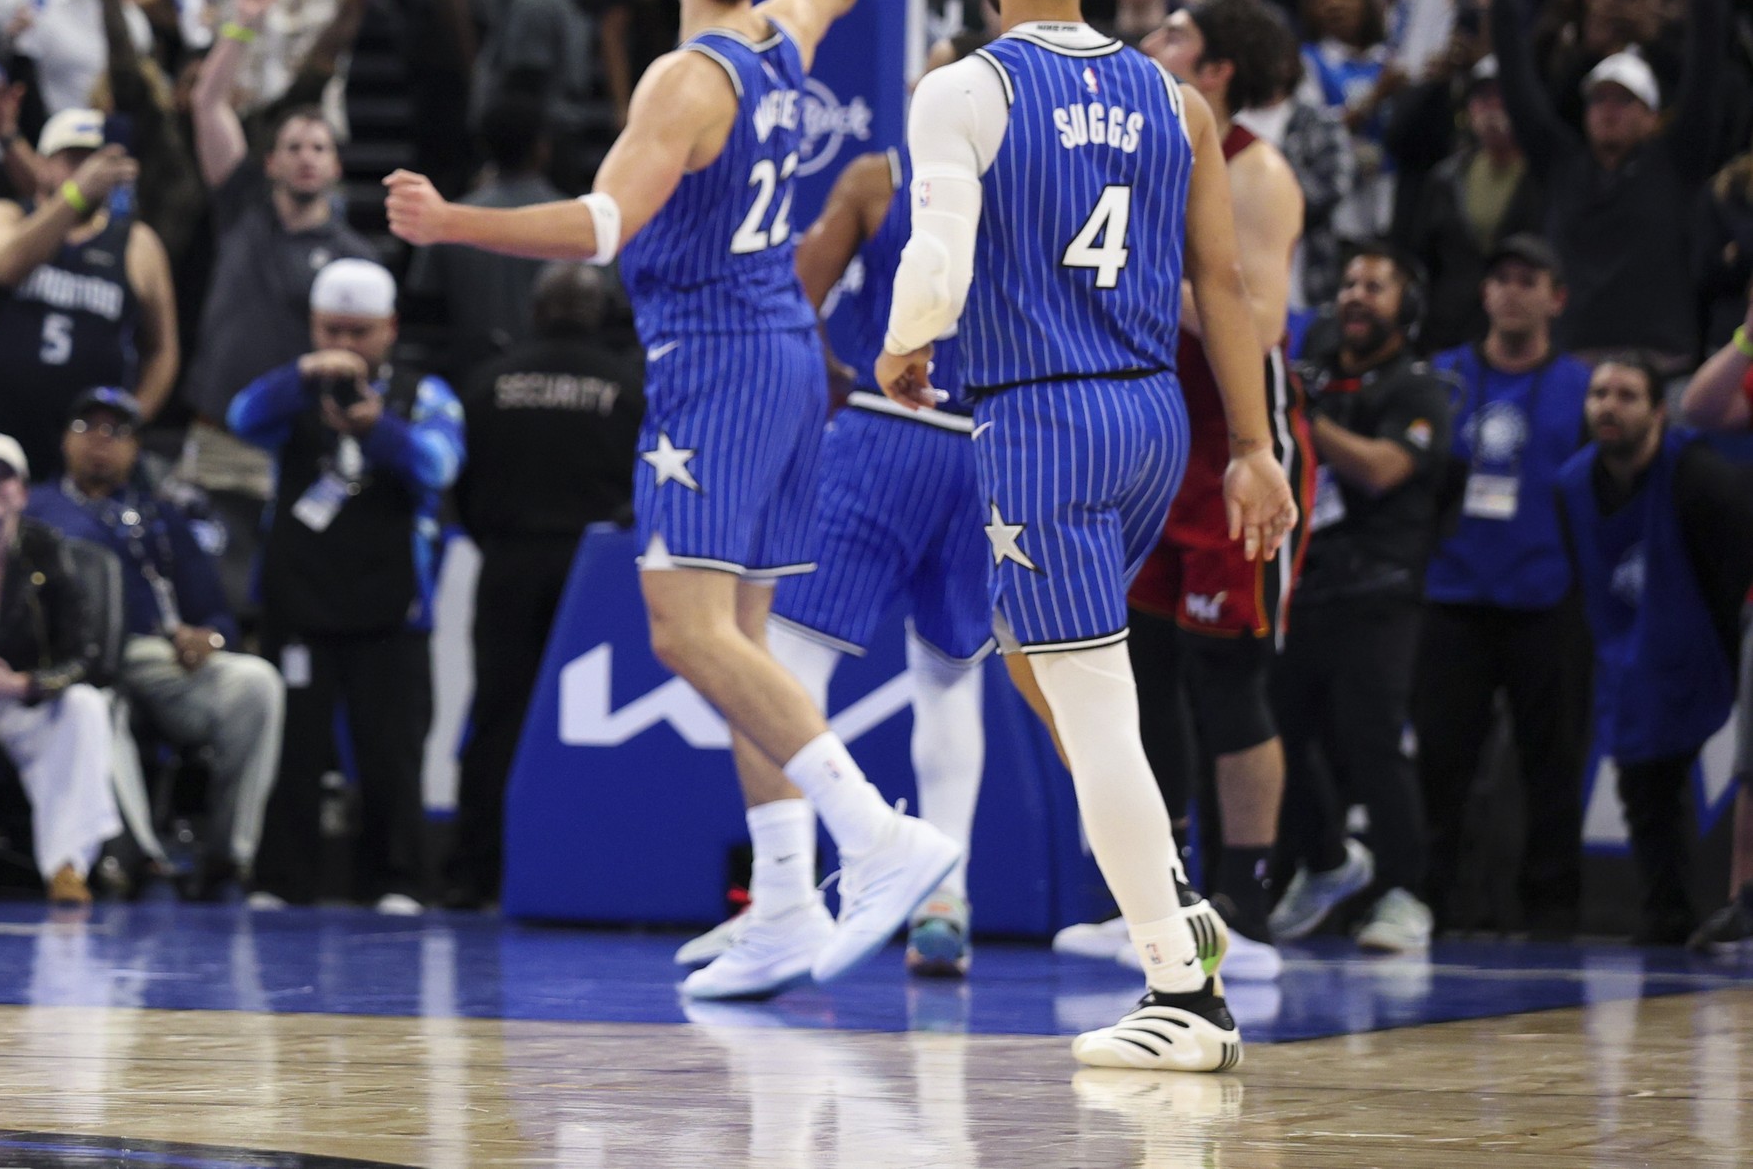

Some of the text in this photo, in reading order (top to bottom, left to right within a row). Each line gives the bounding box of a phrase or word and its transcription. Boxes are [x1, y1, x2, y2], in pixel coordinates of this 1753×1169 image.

[1052, 101, 1144, 154] SUGGS
[1061, 184, 1133, 289] 4
[39, 312, 75, 365] 5
[494, 372, 621, 418] SECURITY
